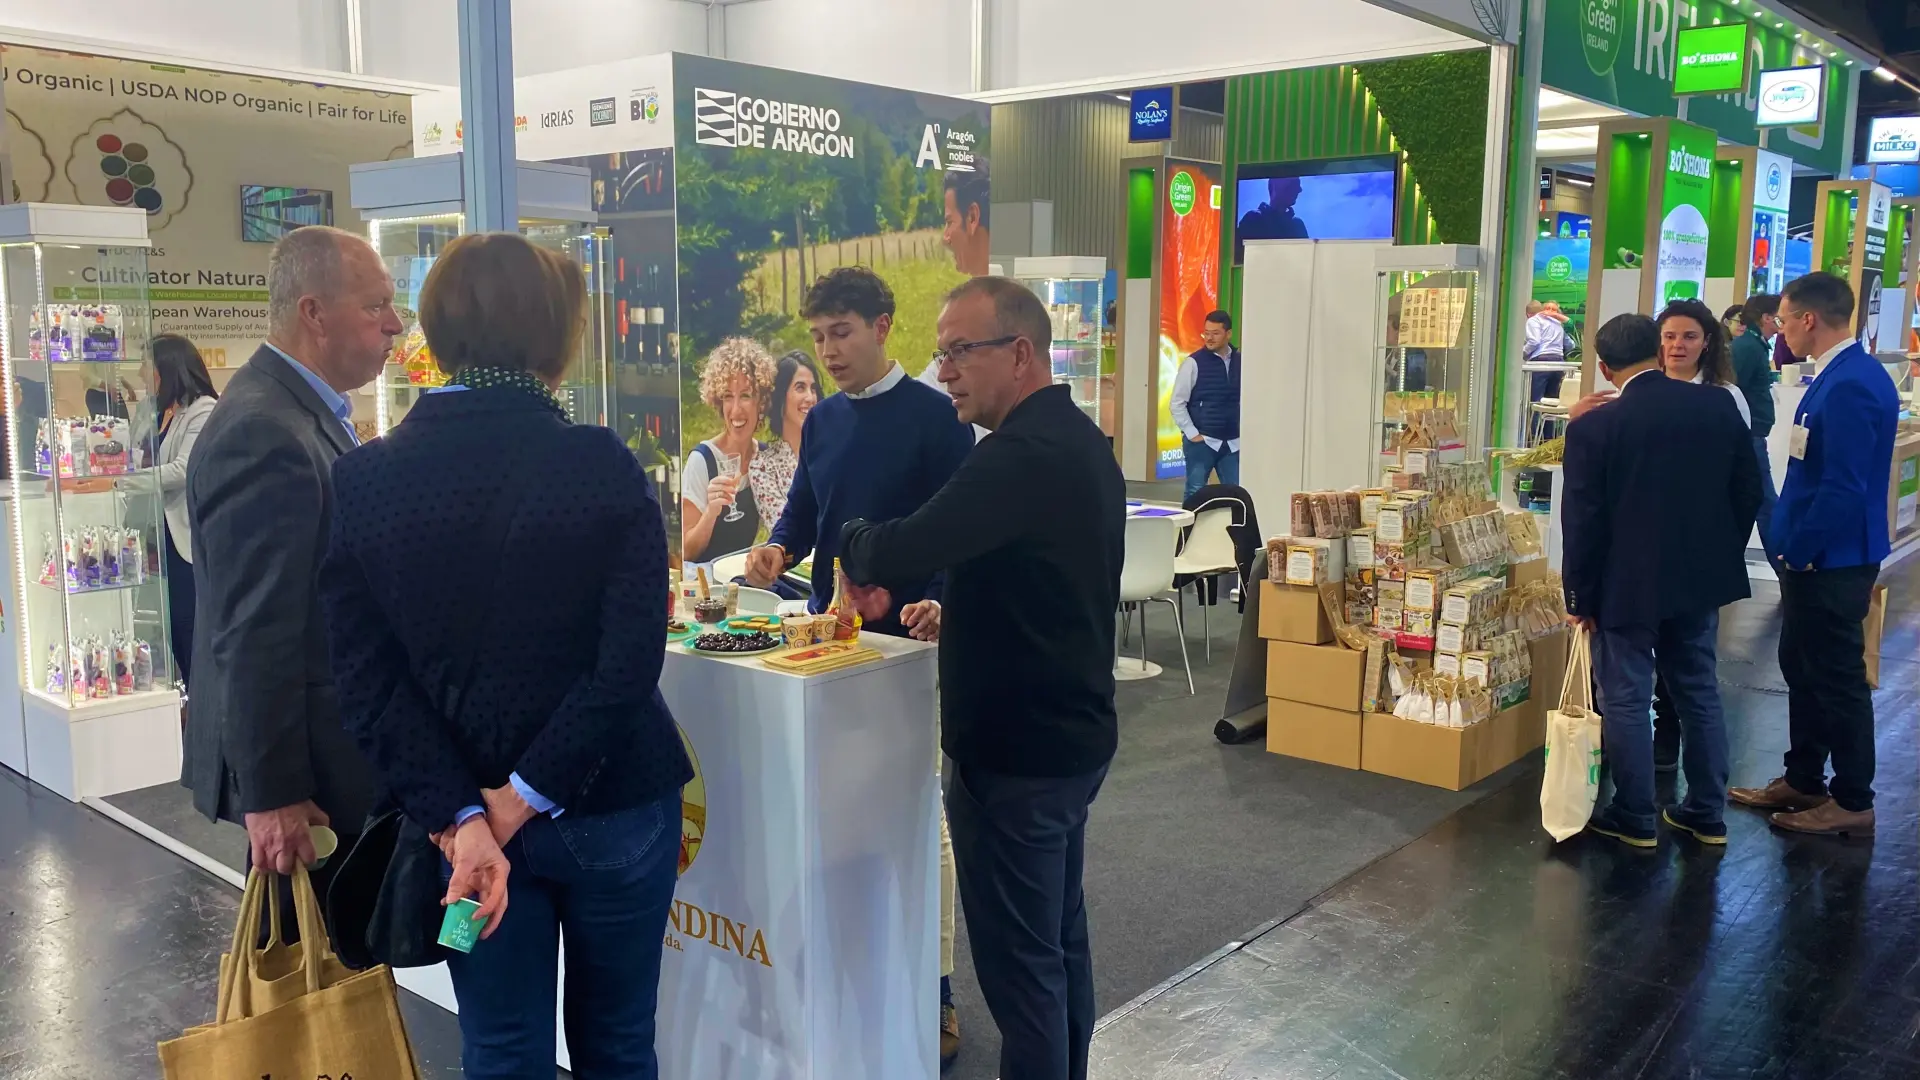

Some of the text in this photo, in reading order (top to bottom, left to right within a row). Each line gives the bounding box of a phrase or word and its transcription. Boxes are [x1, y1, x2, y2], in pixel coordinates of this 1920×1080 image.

[1588, 1, 1616, 35] Green
[1587, 33, 1609, 52] IRELAND
[17, 68, 103, 92] Organic
[121, 80, 179, 100] USDA
[184, 87, 226, 105] NOP
[232, 93, 303, 113] Organic
[318, 102, 348, 119] Fair
[352, 106, 374, 121] for
[379, 109, 407, 124] Life
[737, 97, 841, 132] GOBIERNO
[1135, 109, 1168, 120] NOLAN'S
[738, 123, 854, 158] DE ARAGON
[1876, 142, 1904, 151] MILK
[949, 151, 975, 163] nobles
[1174, 182, 1192, 194] Origin
[1174, 191, 1192, 202] Green
[82, 266, 267, 287] Cultivator Natura
[215, 323, 243, 332] Supply
[244, 322, 253, 331] of
[663, 933, 684, 952] da.
[668, 899, 773, 967] NDINA
